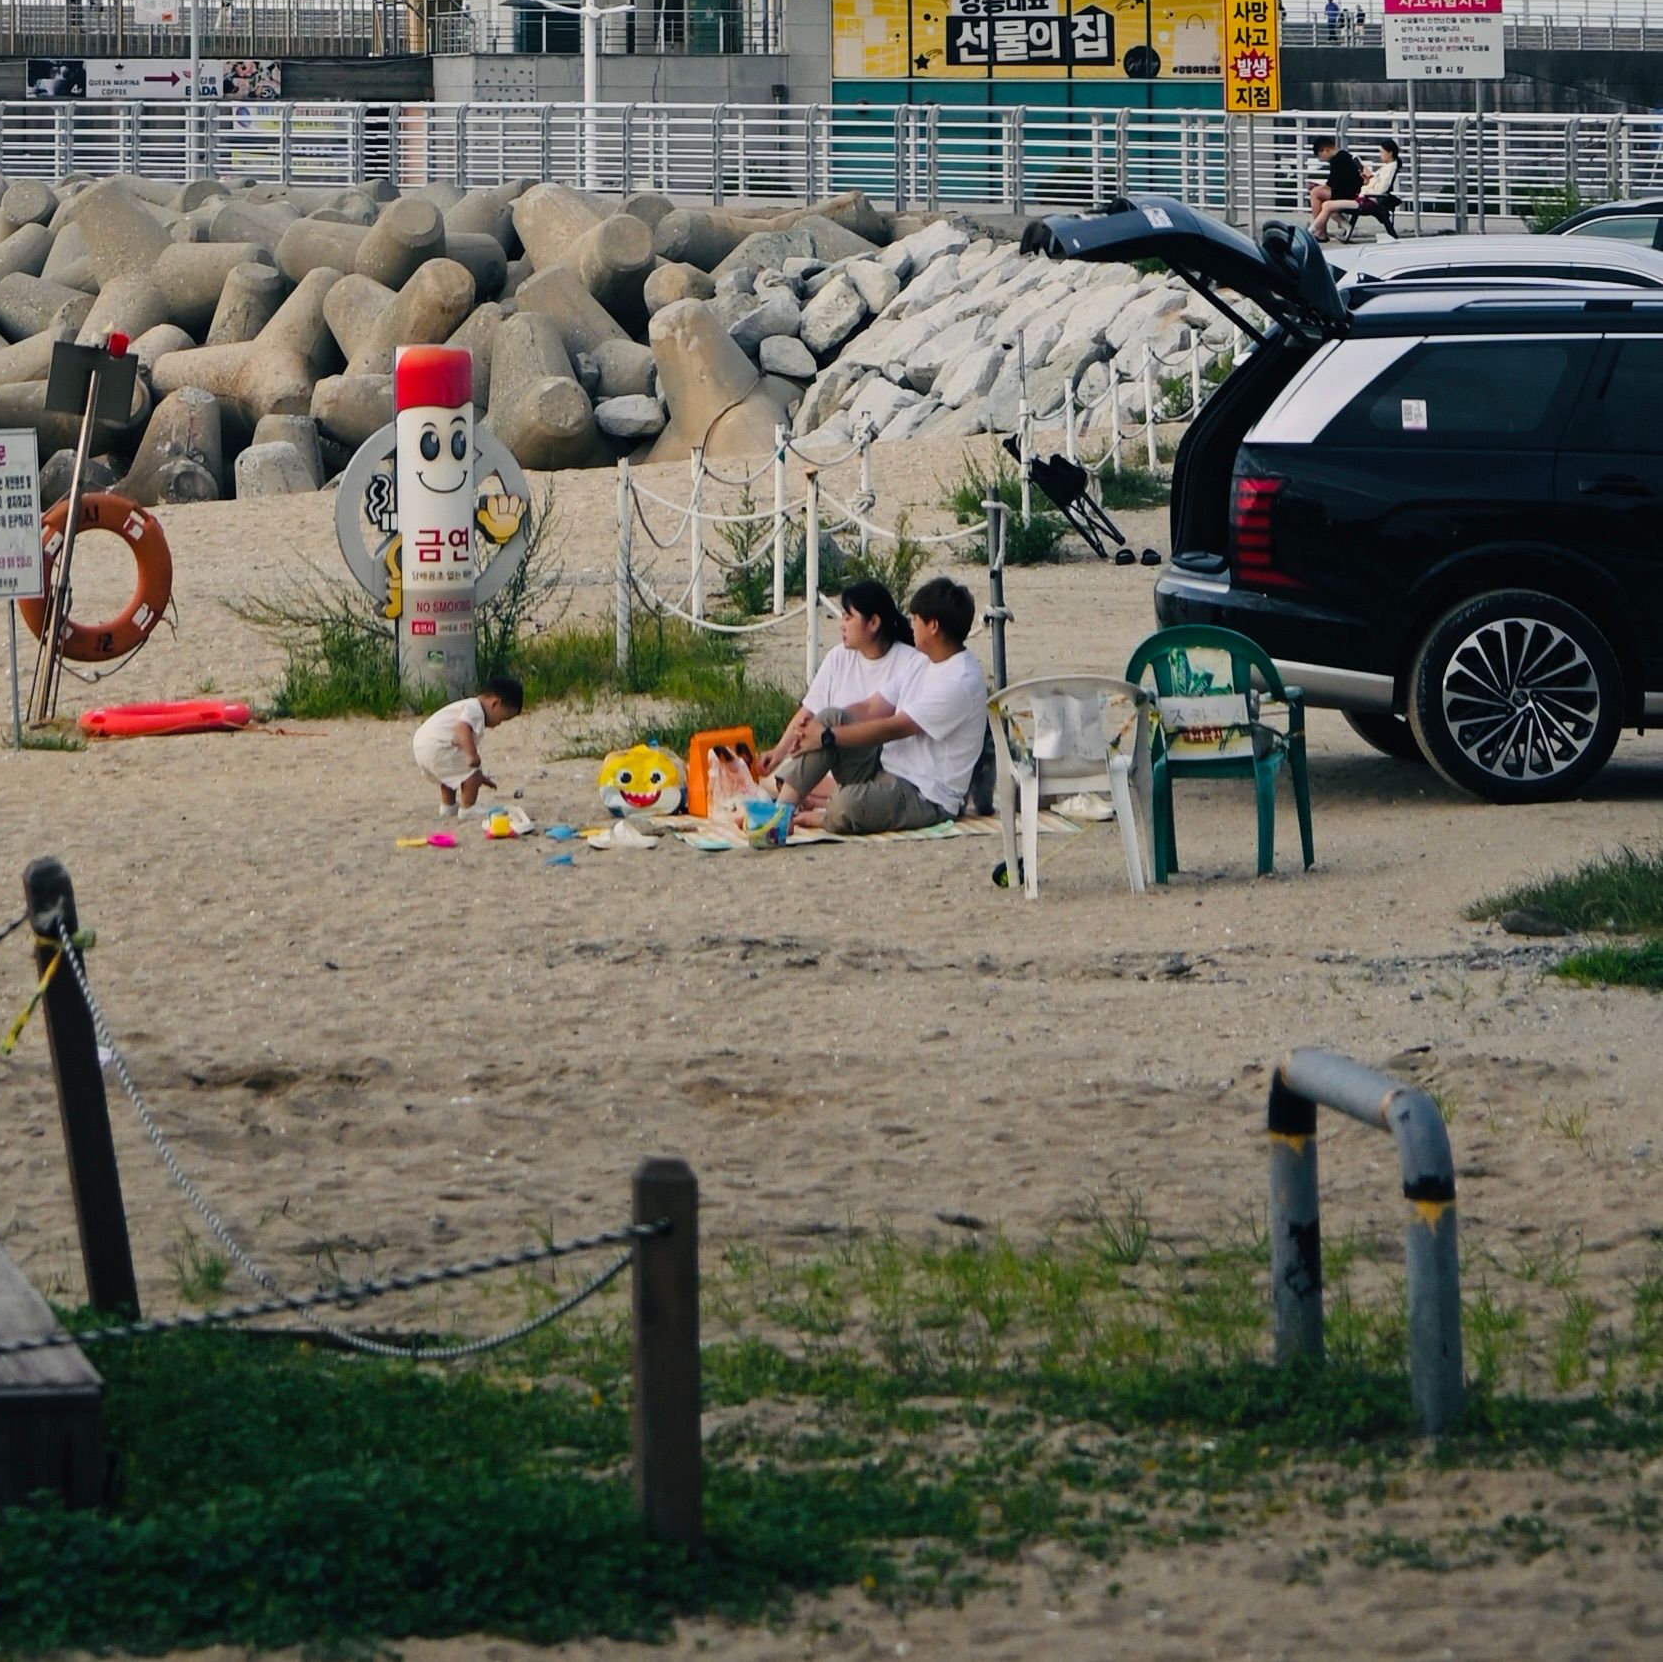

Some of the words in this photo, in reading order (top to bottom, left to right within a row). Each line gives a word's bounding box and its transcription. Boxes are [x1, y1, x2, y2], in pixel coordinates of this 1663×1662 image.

[1233, 0, 1269, 23] 사망
[955, 18, 1061, 63] 선물의
[1071, 13, 1109, 60] 집
[1234, 26, 1269, 48] 사고
[1236, 57, 1268, 78] 발생
[1235, 85, 1270, 108] 지점
[415, 527, 469, 563] 금연
[416, 601, 430, 614] NO
